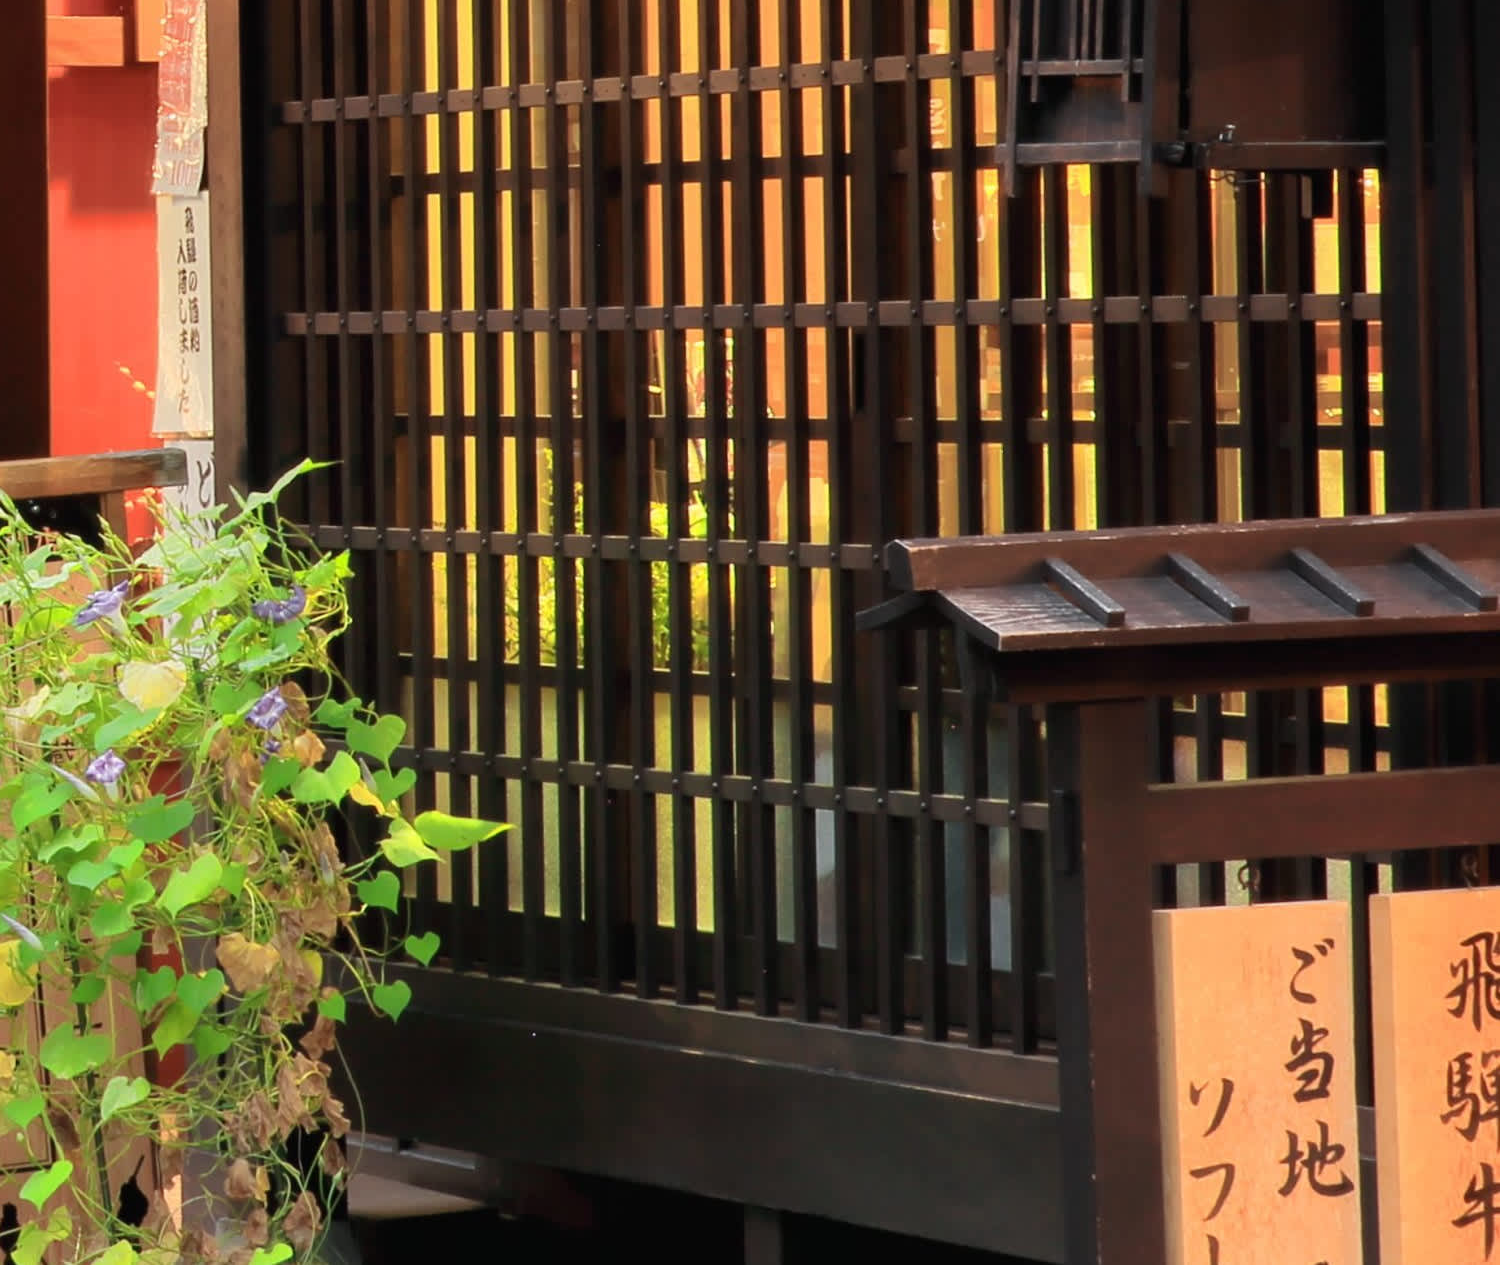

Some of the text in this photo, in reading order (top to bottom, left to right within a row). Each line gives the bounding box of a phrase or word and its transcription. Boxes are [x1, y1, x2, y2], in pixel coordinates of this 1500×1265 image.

[177, 238, 191, 415] 入荷しました
[1278, 938, 1355, 1197] ご当地
